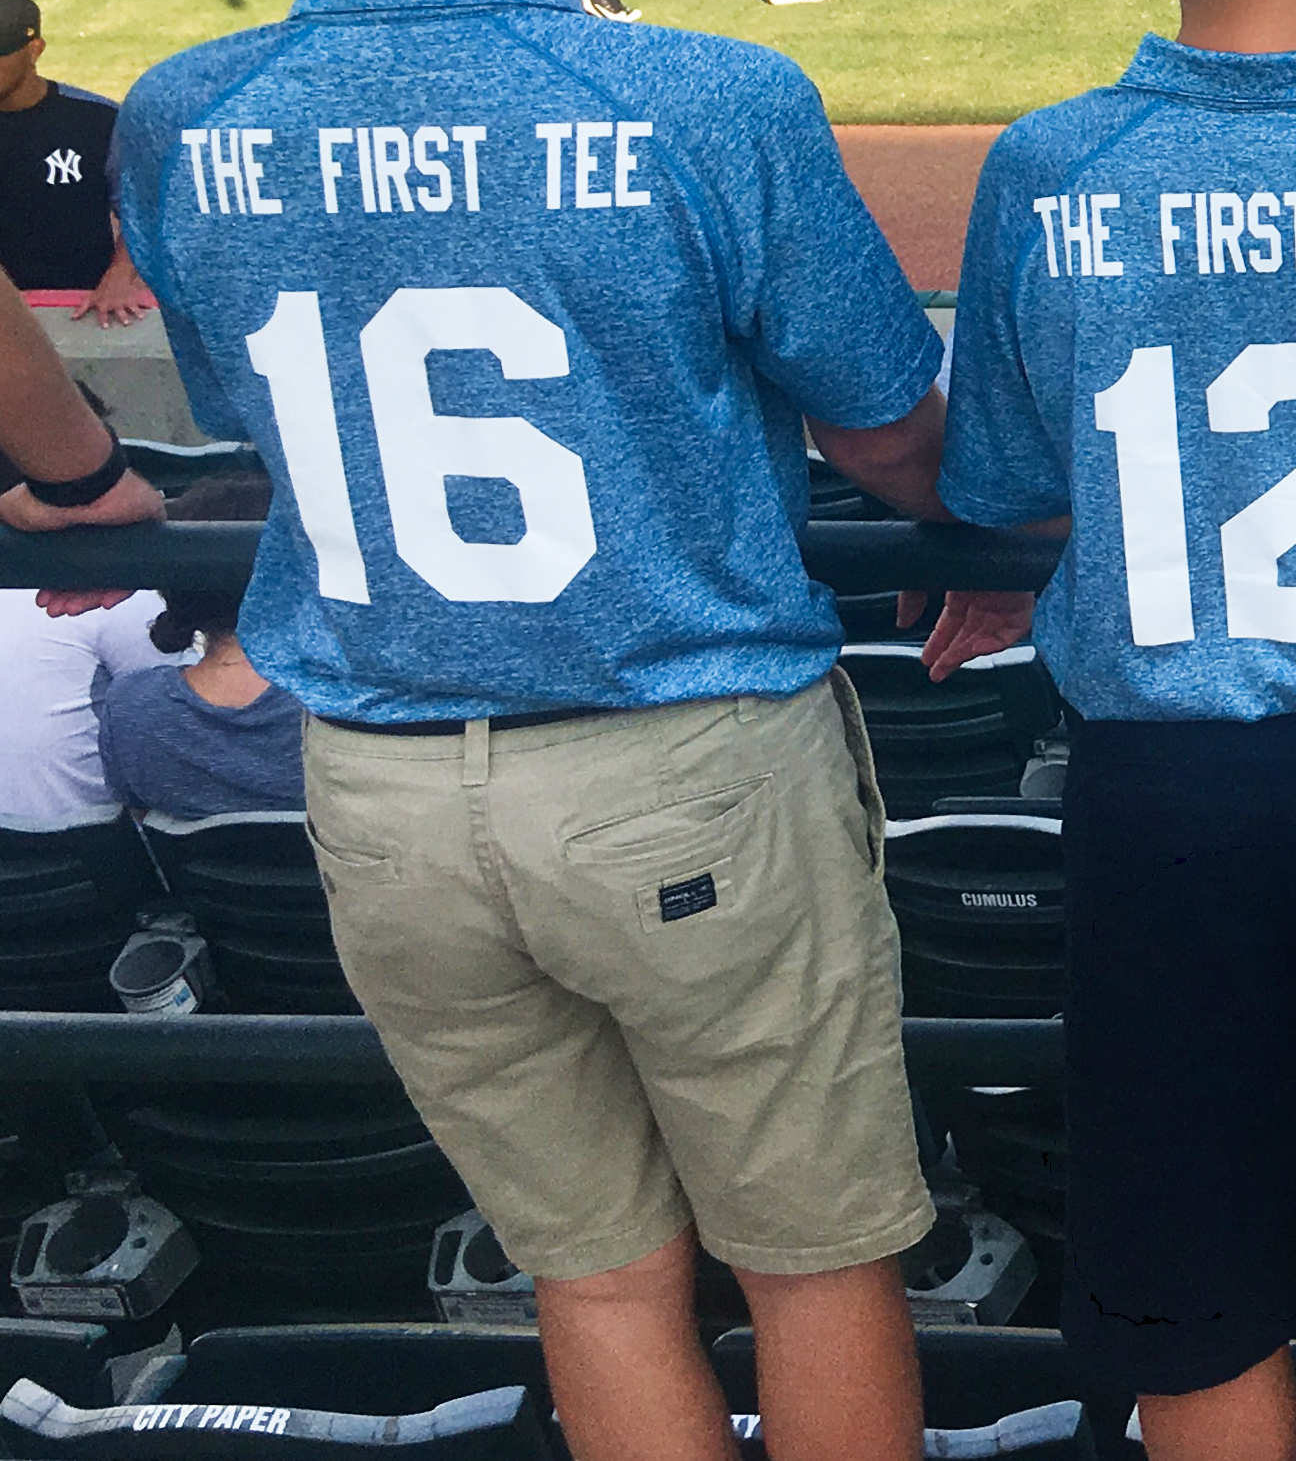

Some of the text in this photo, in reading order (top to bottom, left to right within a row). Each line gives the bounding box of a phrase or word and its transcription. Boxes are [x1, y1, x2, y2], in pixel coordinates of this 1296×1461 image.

[43, 148, 83, 186] NY
[181, 120, 654, 216] THE FIRST TEE
[1032, 192, 1124, 279] THE
[244, 285, 598, 605] 16
[960, 892, 1039, 908] CUMULUS
[132, 1403, 291, 1436] CITY PAPER
